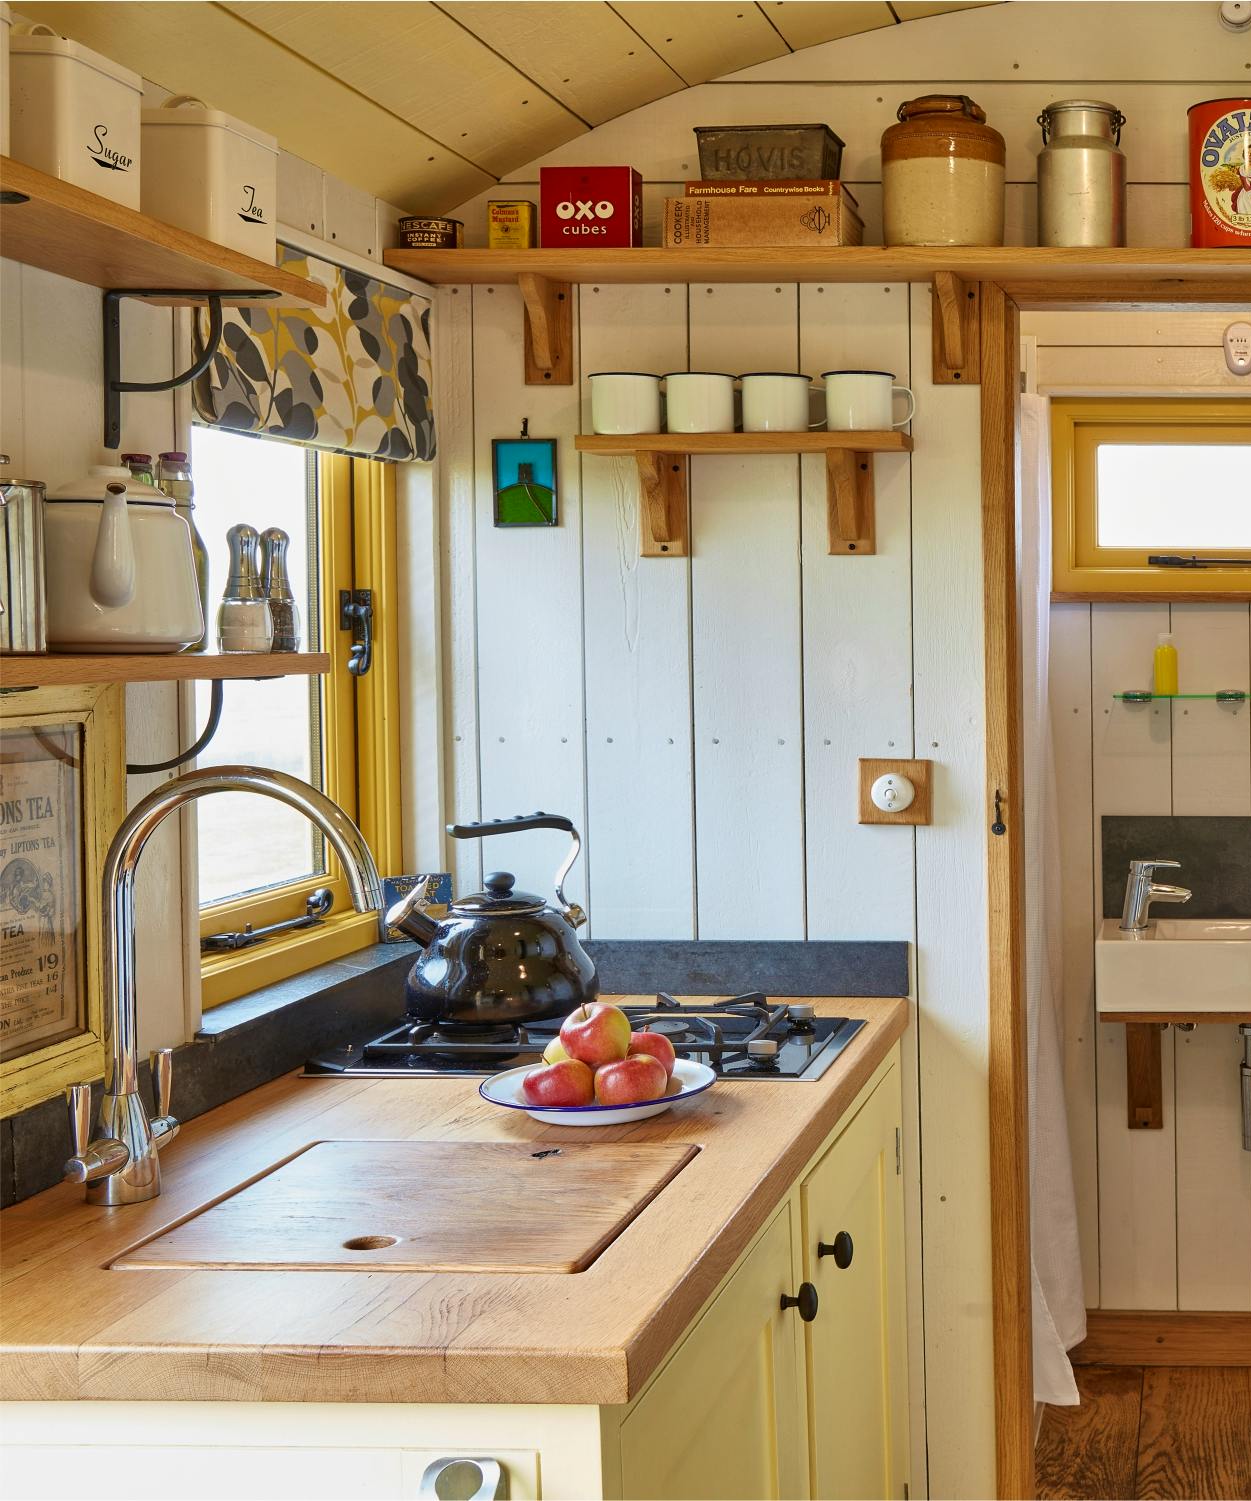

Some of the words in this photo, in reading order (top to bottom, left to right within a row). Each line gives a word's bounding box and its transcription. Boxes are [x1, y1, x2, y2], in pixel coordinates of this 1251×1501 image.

[86, 124, 133, 170] Sugar
[1229, 132, 1243, 144] JUST
[713, 144, 806, 173] HOVIS
[689, 186, 737, 194] Farmhouse
[738, 185, 758, 193] Fare
[763, 186, 804, 194] Countrywise
[804, 185, 825, 193] Books
[240, 185, 263, 218] Tea
[555, 200, 615, 220] OXO
[562, 223, 608, 235] cubes
[673, 200, 683, 245] COOKERY
[703, 200, 711, 244] MANAGEMENT
[1211, 215, 1222, 226] 120
[1220, 223, 1235, 234] cups
[26, 796, 54, 820] TEA
[10, 839, 40, 855] LIPTONS
[42, 836, 56, 849] TEA
[394, 882, 440, 893] TOAED
[1, 923, 24, 940] TEA
[10, 967, 33, 979] Produce
